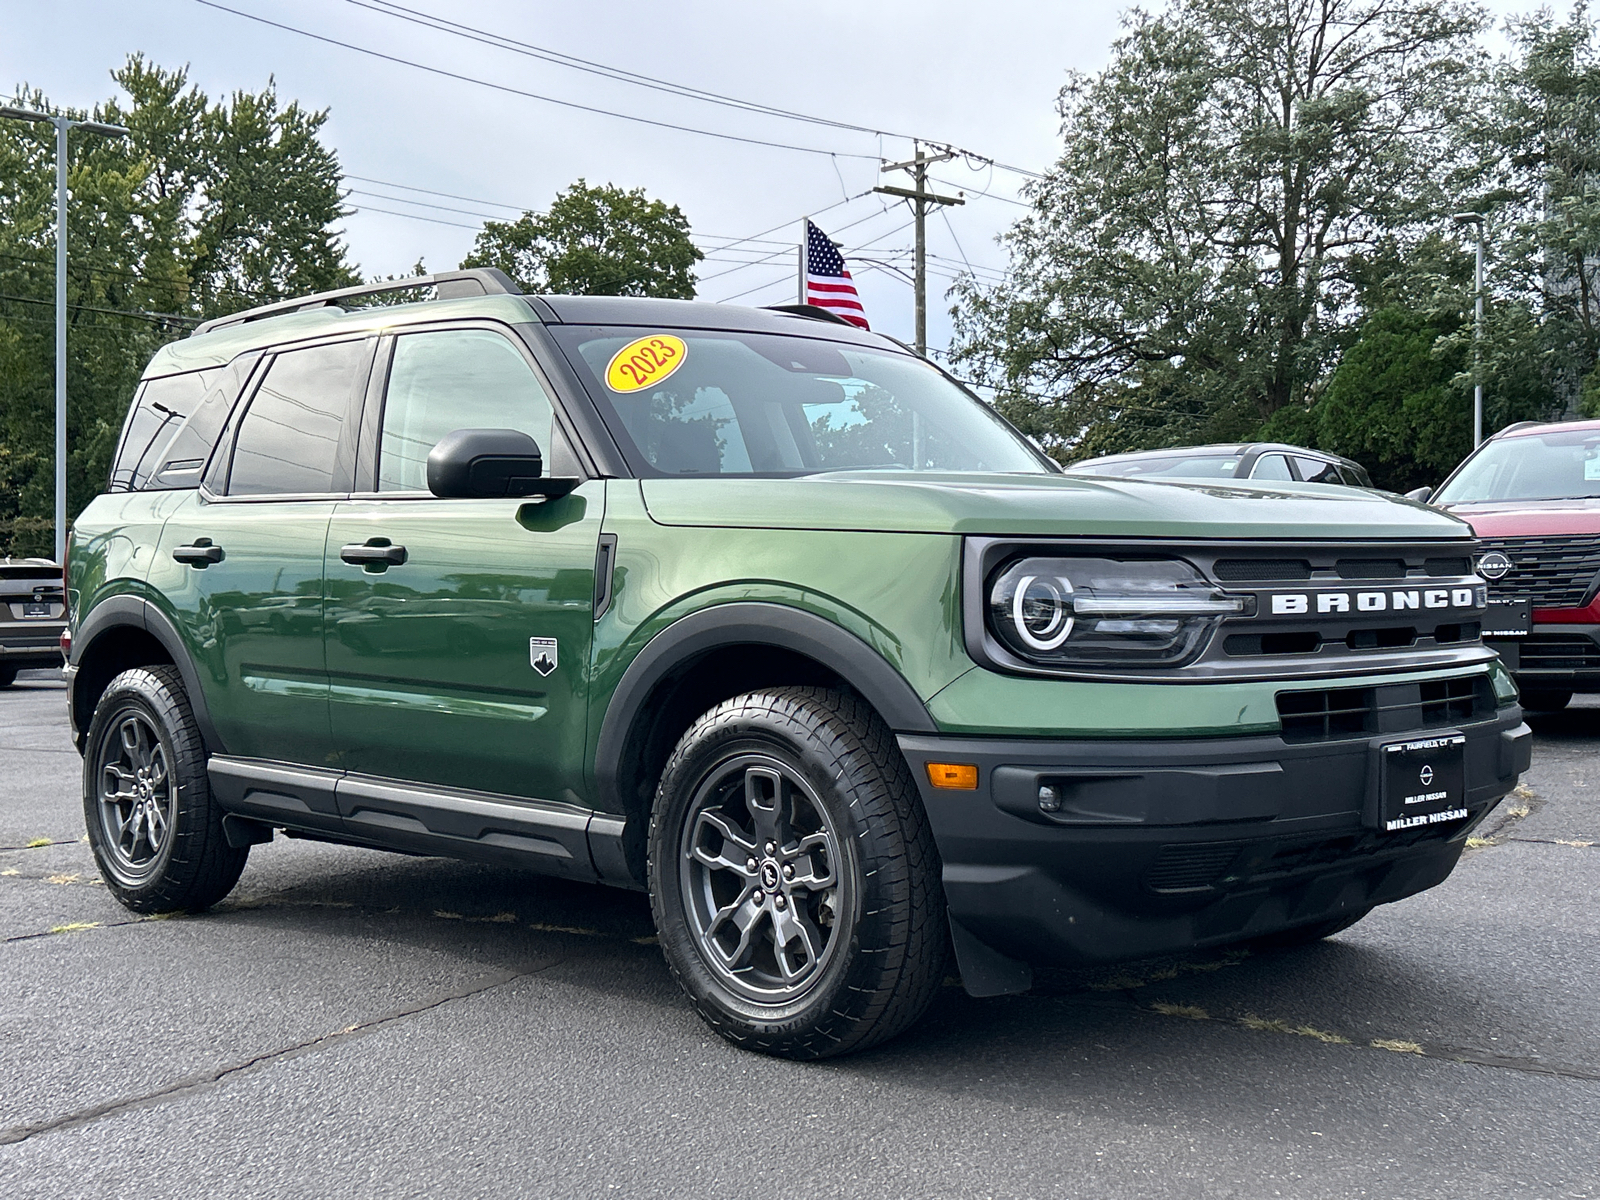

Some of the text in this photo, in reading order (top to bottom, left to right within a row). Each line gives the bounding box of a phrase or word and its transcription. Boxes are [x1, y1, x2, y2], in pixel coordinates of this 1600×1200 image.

[620, 340, 676, 385] 2023
[1271, 589, 1472, 614] BRONCO
[1405, 791, 1447, 804] MILLER NISSAN
[1387, 808, 1467, 830] MILLER NISSAN
